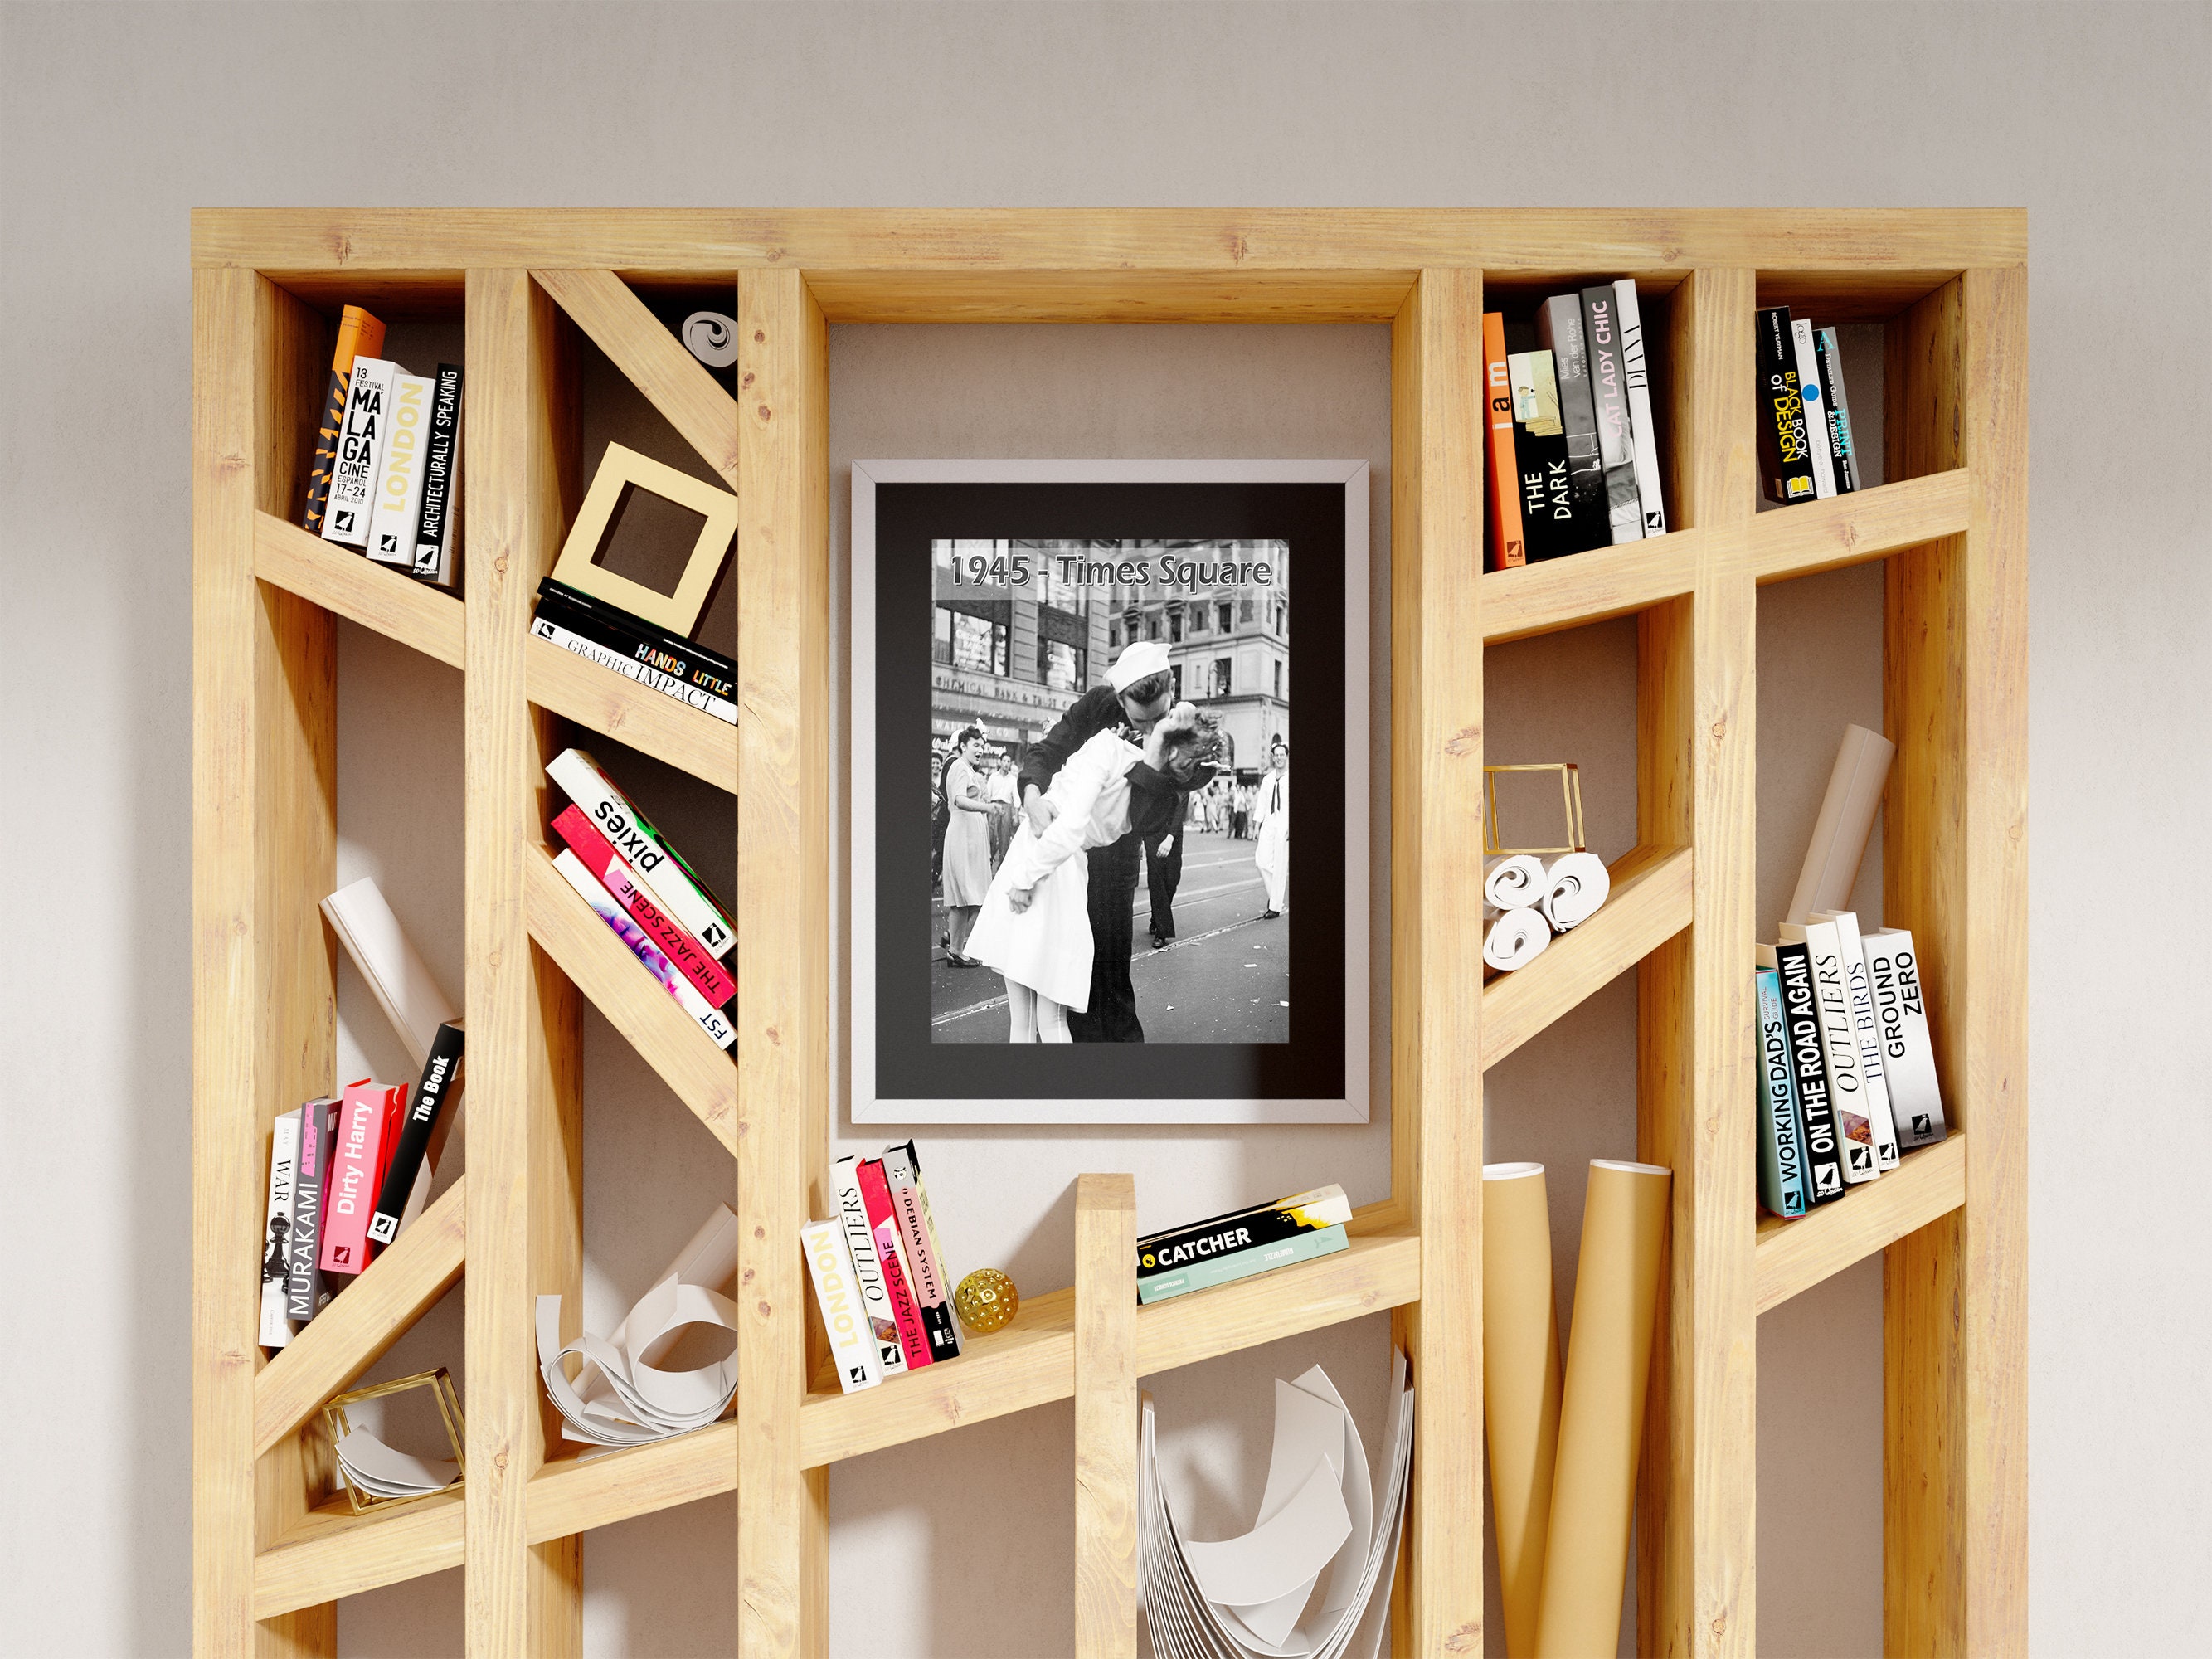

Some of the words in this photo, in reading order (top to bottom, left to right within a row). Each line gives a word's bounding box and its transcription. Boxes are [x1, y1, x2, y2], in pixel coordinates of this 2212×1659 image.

[1567, 318, 1577, 342] Rohe
[1592, 299, 1612, 344] CHIC
[1771, 311, 1779, 333] ROBERT
[1795, 322, 1807, 345] logo
[1816, 331, 1836, 352] A
[1560, 357, 1570, 380] Mies
[1569, 343, 1579, 359] der
[1573, 361, 1581, 377] van
[355, 379, 385, 391] FESTIVAL
[357, 367, 367, 379] 13
[1597, 350, 1617, 401] LADY
[1771, 374, 1787, 392] of
[1784, 371, 1802, 414] BLACK
[436, 371, 458, 427] SPEAKING
[347, 411, 376, 440] LA
[1604, 402, 1623, 440] CAT
[1774, 397, 1798, 463] DESIGN
[1791, 418, 1809, 459] BOOK
[1835, 409, 1853, 457] PRINT
[343, 437, 371, 465] GA
[383, 382, 424, 513] LONDON
[336, 483, 366, 499] 17-24
[339, 462, 371, 479] CINE
[423, 431, 450, 537] ARCHITECTURALLY
[1548, 460, 1572, 520] DARK
[333, 494, 349, 503] ABRIL
[350, 496, 364, 505] 2010
[1524, 472, 1545, 514] THE
[951, 554, 1030, 586] 1945
[1056, 554, 1151, 586] Times
[1159, 554, 1273, 596] Square
[567, 640, 633, 676] GRAPHIC
[634, 665, 716, 712] IMPACT
[635, 644, 686, 677] HANDS
[692, 669, 732, 696] LITTLE
[594, 800, 664, 873] pixies
[620, 881, 664, 929] SCENE
[659, 924, 697, 965] JAZZ
[692, 961, 721, 995] THE
[1782, 954, 1814, 1017] AGAIN
[1846, 961, 1876, 1035] BIRDS
[1895, 951, 1922, 1016] ZERO
[699, 1013, 727, 1040] FST
[1815, 955, 1860, 1093] OUTLIERS
[1873, 956, 1906, 1058] GROUND
[1766, 1021, 1788, 1081] DAD'S
[1793, 1020, 1822, 1078] ROAD
[1860, 1038, 1883, 1084] THE
[423, 1054, 450, 1094] Book
[412, 1094, 435, 1123] The
[1802, 1080, 1828, 1120] THE
[345, 1100, 373, 1159] Harry
[1772, 1083, 1798, 1183] WORKING
[1809, 1121, 1833, 1154] ON
[274, 1160, 291, 1202] WAR
[337, 1167, 365, 1215] Dirty
[289, 1182, 318, 1315] MURAKAMI
[839, 1187, 884, 1301] OUTLIERS
[883, 1239, 905, 1286] SCENE
[904, 1198, 923, 1246] DEBIAN
[917, 1248, 937, 1299] SYSTEM
[1158, 1228, 1252, 1266] CATCHER
[809, 1231, 859, 1349] LONDON
[897, 1289, 915, 1325] JAZZ
[905, 1330, 921, 1358] THE
